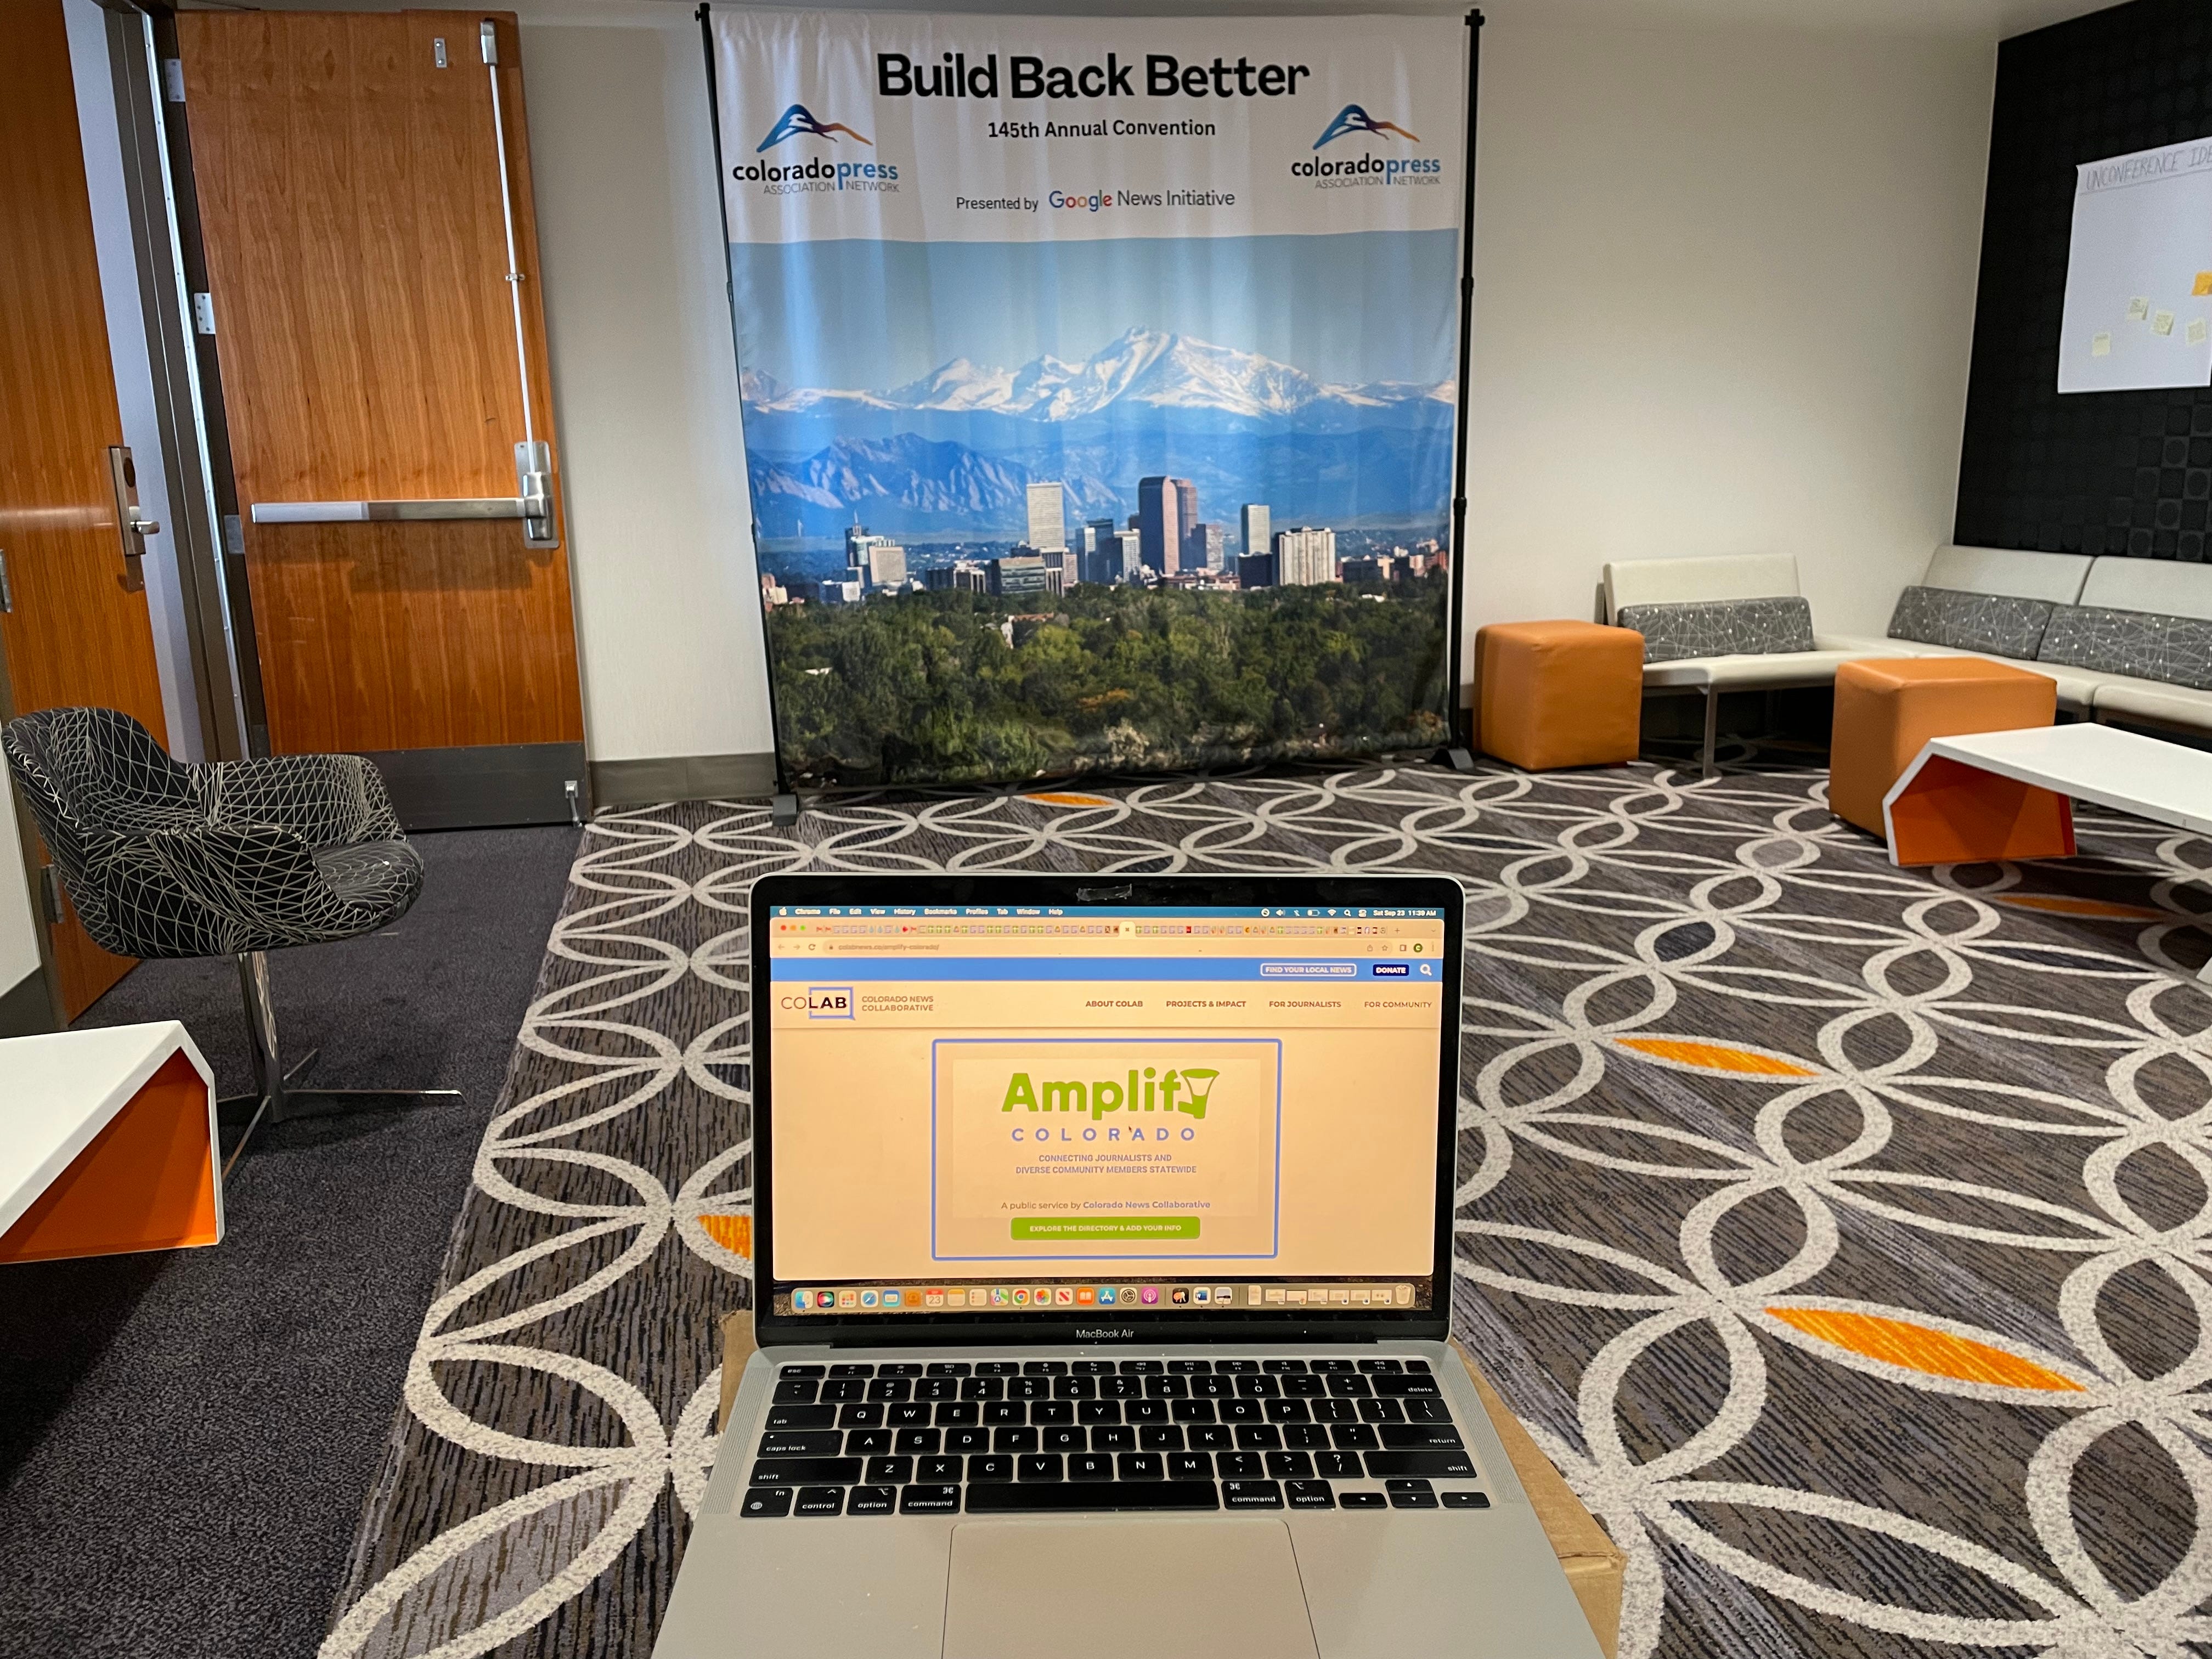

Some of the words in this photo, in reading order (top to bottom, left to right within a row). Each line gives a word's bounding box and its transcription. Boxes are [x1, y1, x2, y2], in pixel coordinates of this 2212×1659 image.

[878, 52, 997, 98] Build
[1011, 53, 1135, 98] Back
[1147, 54, 1310, 98] Better
[989, 122, 1039, 138] 145th
[1045, 120, 1108, 137] Annual
[1113, 119, 1215, 135] Convention
[1315, 174, 1384, 189] ASSOCIATION
[1393, 174, 1441, 187] NETWORK
[763, 180, 836, 195] ASSOCIATION
[845, 179, 900, 194] NETWORK
[956, 198, 1019, 210] Presented
[1024, 198, 1039, 212] by
[1049, 190, 1111, 212] Google
[1118, 190, 1161, 206] News
[1167, 190, 1234, 205] Initiative
[1011, 1128, 1195, 1141] COLORADO
[928, 1295, 941, 1305] 23
[1076, 1329, 1120, 1340] MacBook
[1122, 1328, 1135, 1339] Air
[913, 1436, 922, 1444] S
[963, 1435, 972, 1443] D
[1060, 1434, 1069, 1442] G
[1205, 1432, 1214, 1441] K
[864, 1437, 873, 1445] A
[935, 1464, 945, 1472] X
[985, 1463, 995, 1471] C
[1036, 1462, 1045, 1470] V
[1086, 1462, 1094, 1470] B
[1136, 1461, 1146, 1469] N
[1184, 1460, 1196, 1469] M
[885, 1465, 894, 1473] Z
